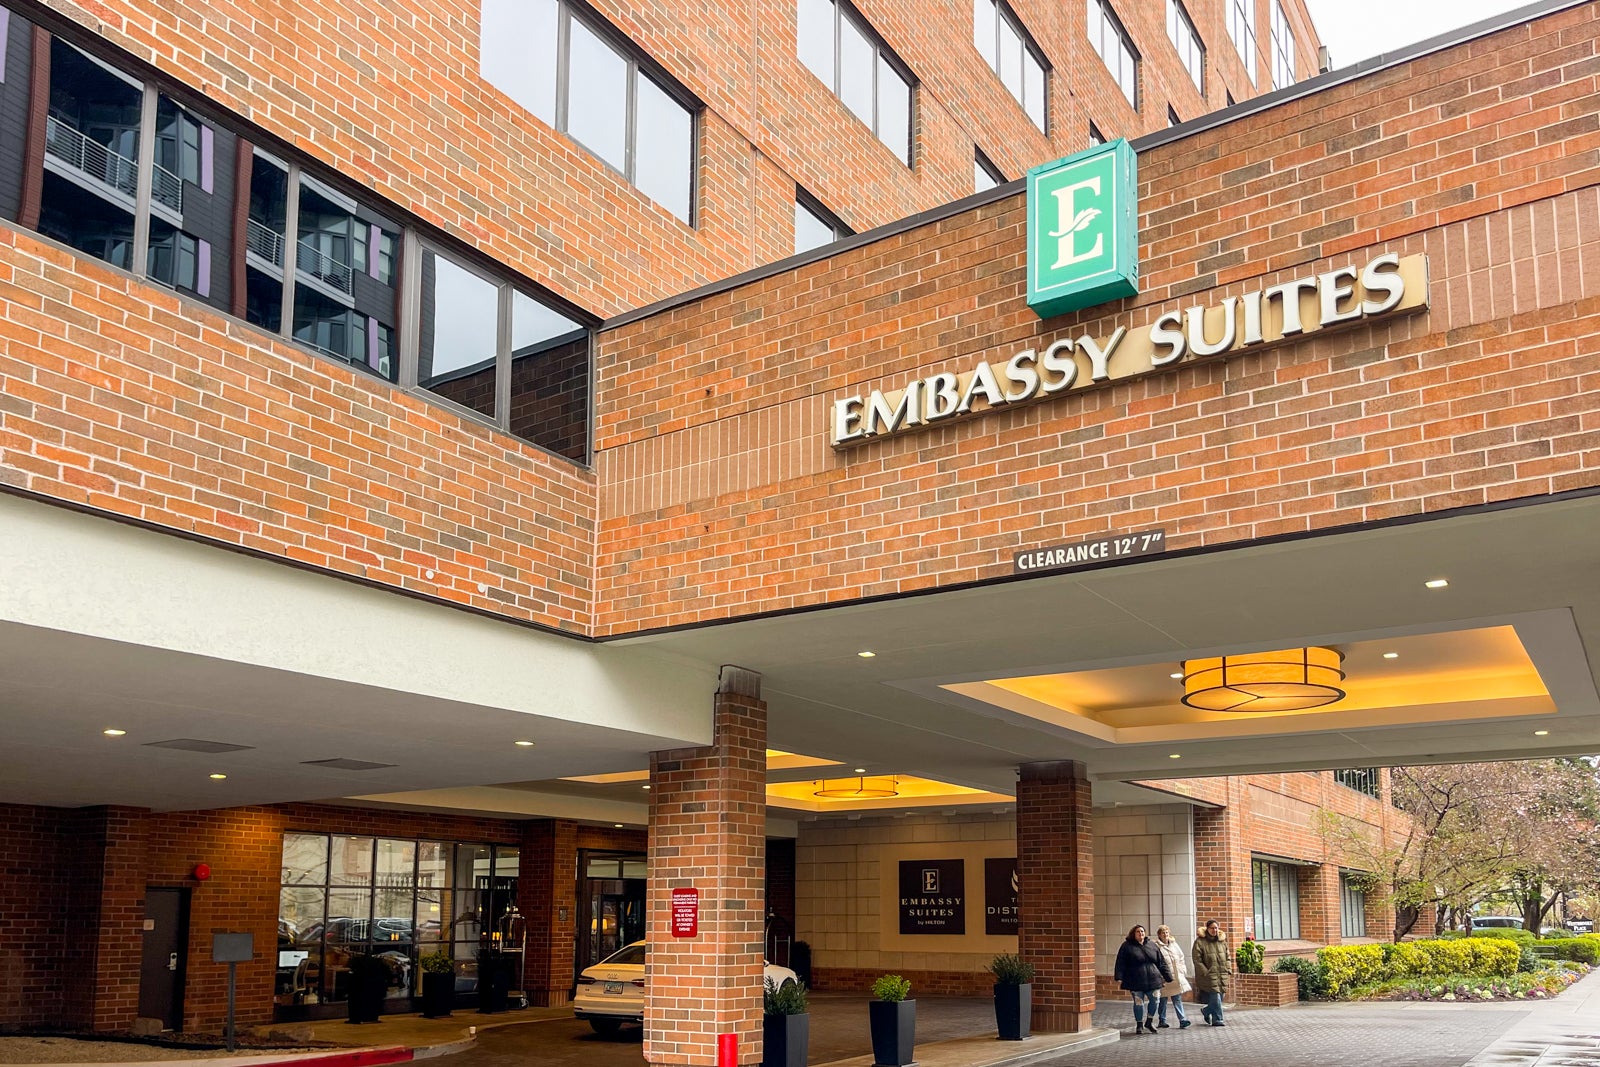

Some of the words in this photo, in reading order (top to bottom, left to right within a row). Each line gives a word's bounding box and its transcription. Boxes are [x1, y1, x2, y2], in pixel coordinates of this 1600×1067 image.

[1050, 176, 1103, 270] E
[833, 325, 1127, 443] EMBASSY
[1149, 252, 1405, 366] SUITES
[1018, 541, 1109, 570] CLEARANCE
[901, 898, 961, 906] EMBASSY
[909, 908, 954, 917] SUITES
